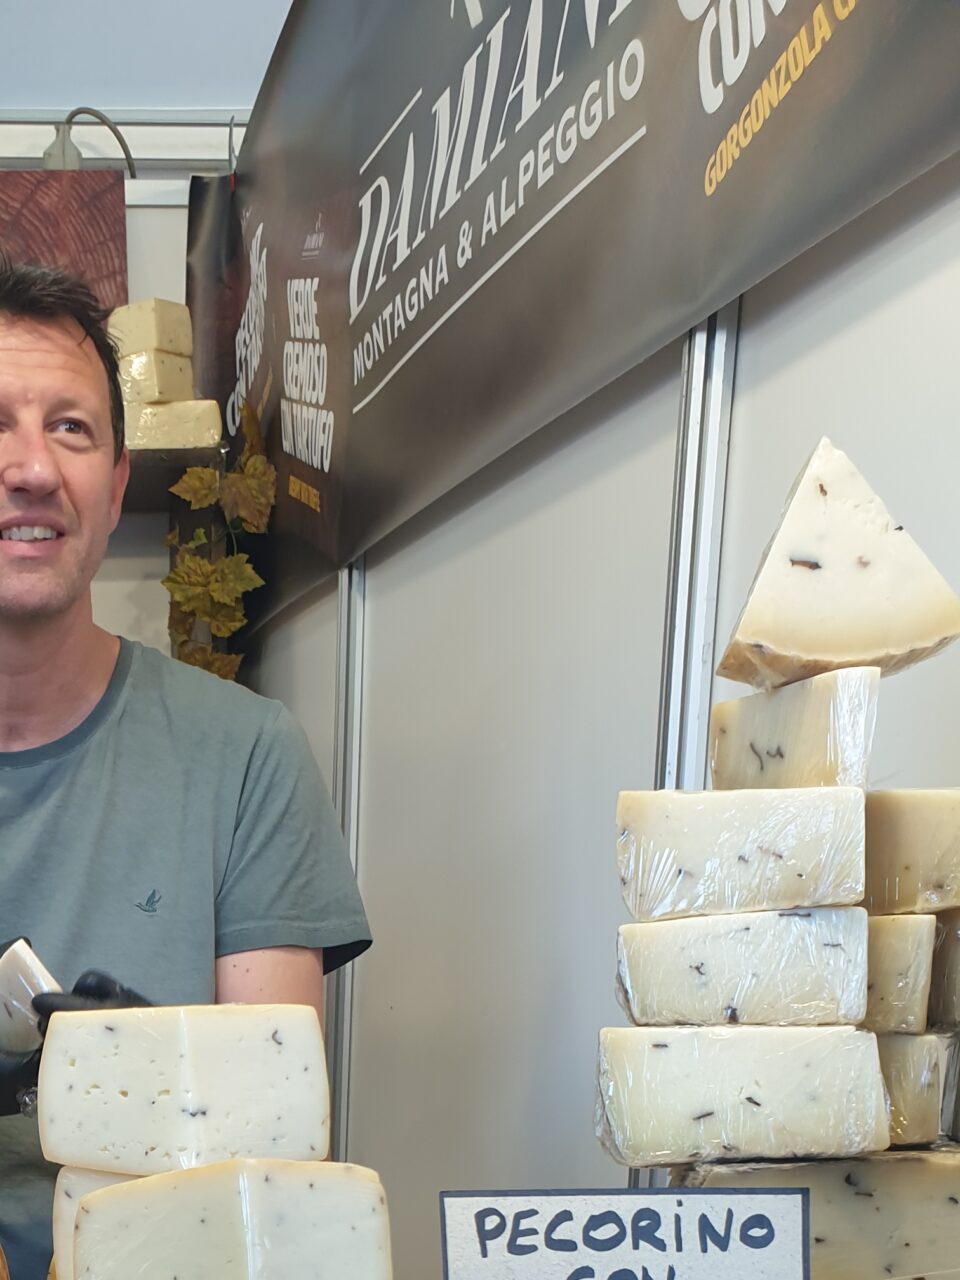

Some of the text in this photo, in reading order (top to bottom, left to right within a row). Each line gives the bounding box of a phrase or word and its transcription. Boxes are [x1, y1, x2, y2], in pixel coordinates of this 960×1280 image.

[349, 0, 632, 325] DAMIAN
[704, 2, 833, 197] GORGONZOLA
[352, 37, 645, 387] MONTAGNA & ALPEGGIO
[283, 340, 328, 406] CREMOSO
[287, 277, 320, 340] VERDE
[292, 402, 335, 474] TARTUFO
